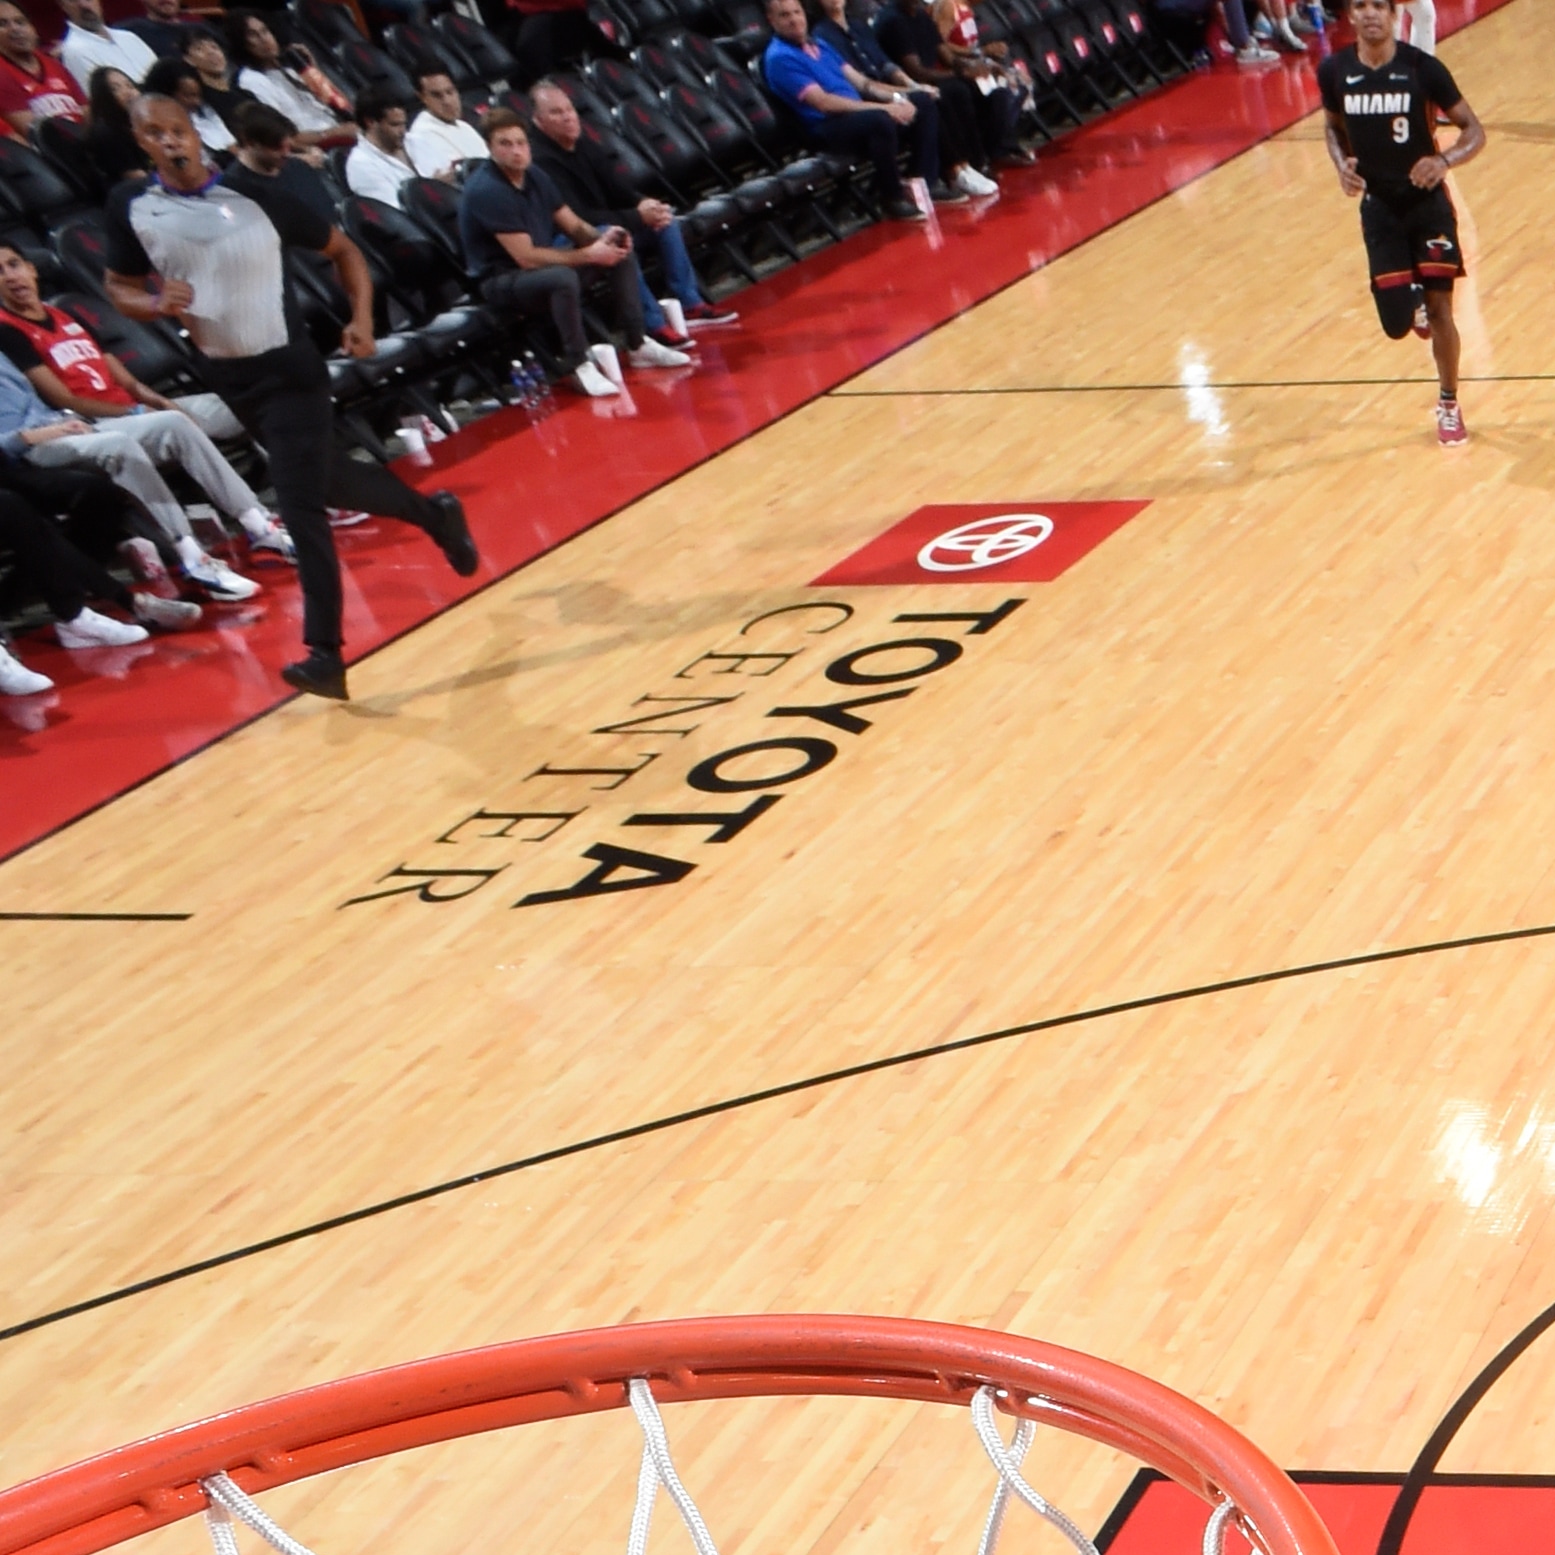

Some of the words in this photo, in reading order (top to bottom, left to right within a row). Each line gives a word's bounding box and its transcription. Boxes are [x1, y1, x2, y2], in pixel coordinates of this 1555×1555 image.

[1344, 93, 1411, 114] MIAMI
[1392, 116, 1410, 143] 9
[336, 601, 855, 907] CENTER
[512, 597, 1029, 909] TOYOTA
